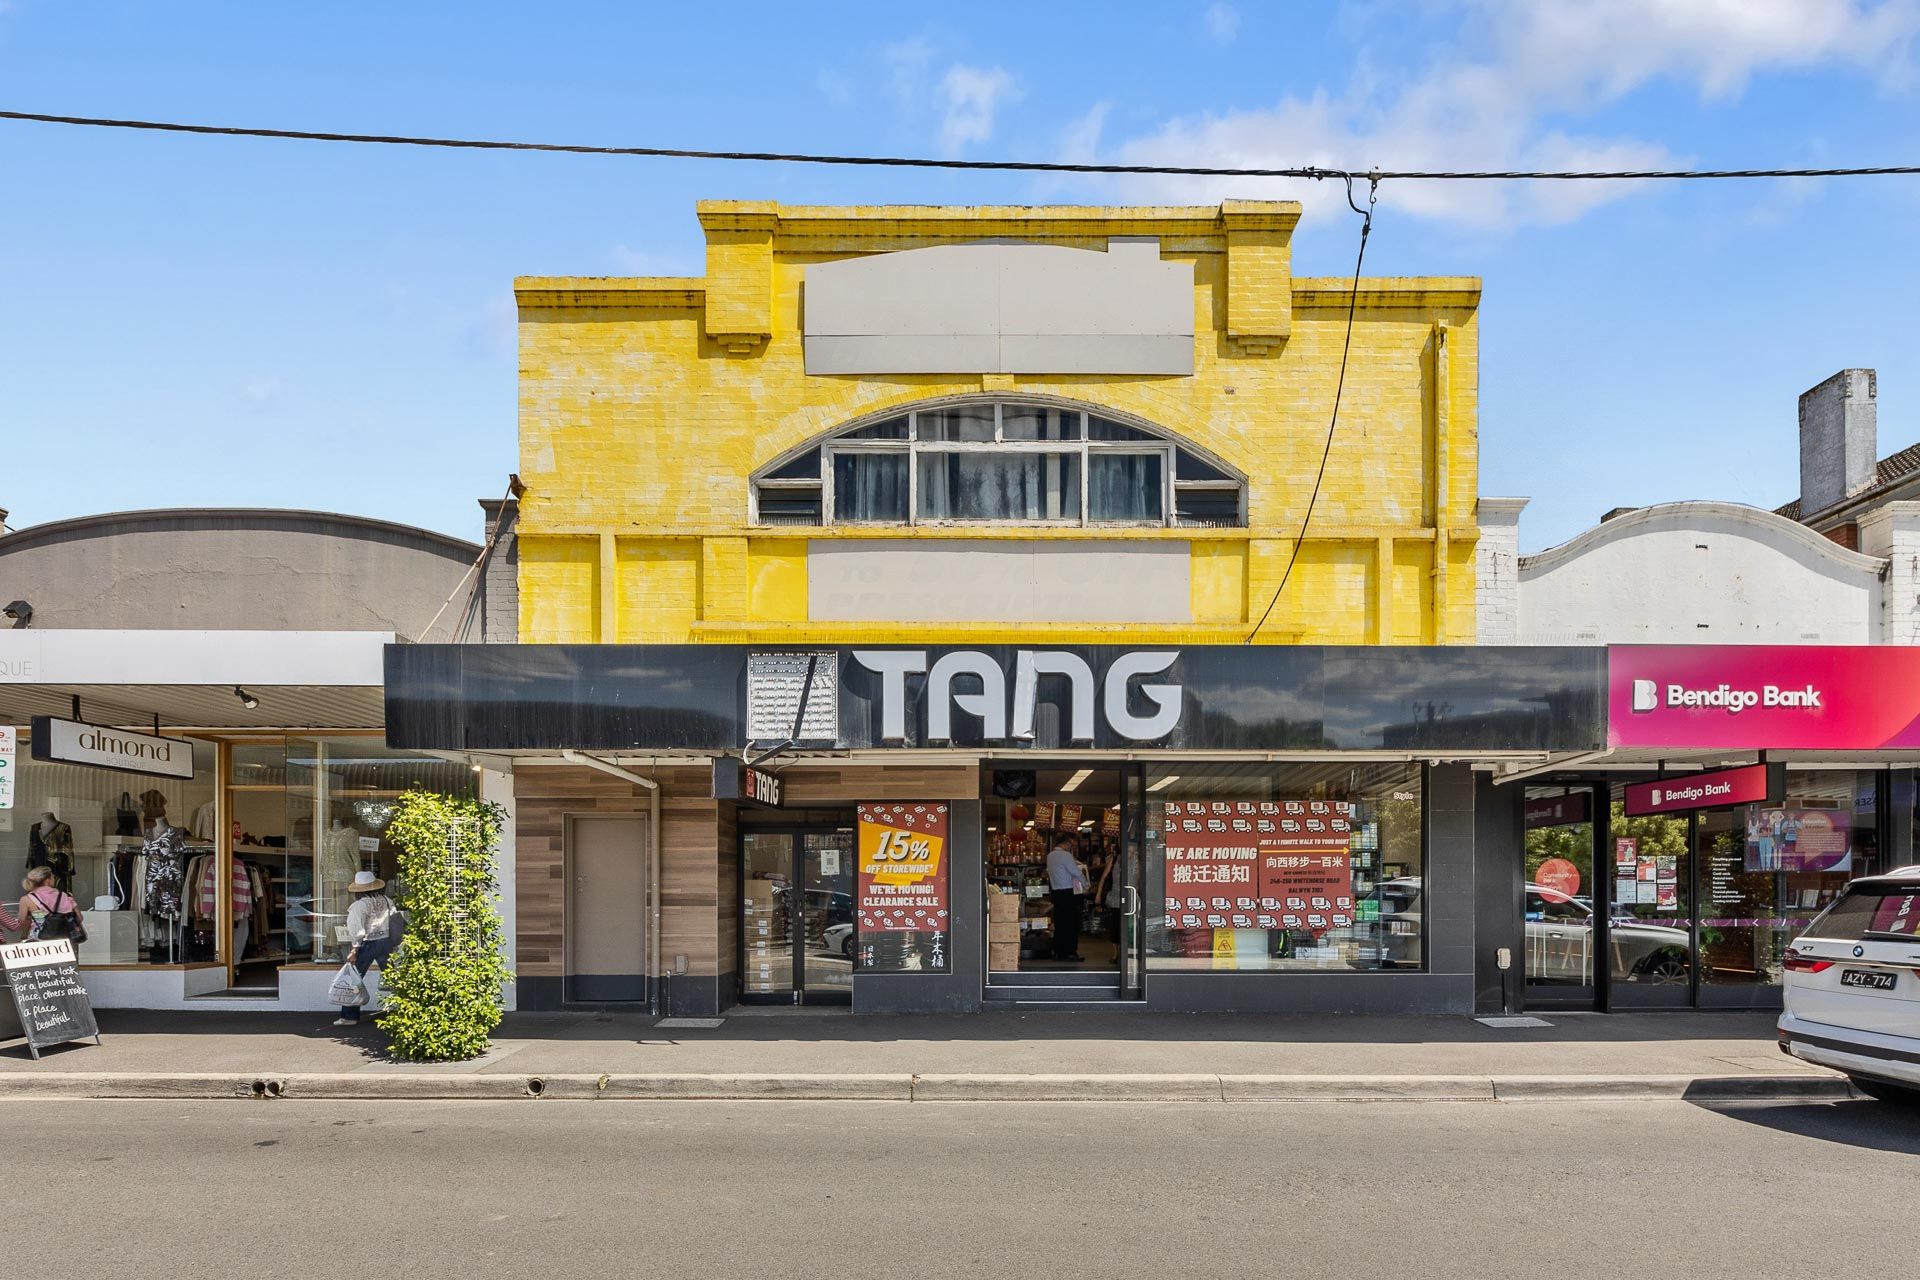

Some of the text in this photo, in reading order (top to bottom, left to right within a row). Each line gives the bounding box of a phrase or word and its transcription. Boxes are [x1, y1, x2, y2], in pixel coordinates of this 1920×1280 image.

[852, 650, 1182, 740] TANG
[1667, 684, 1758, 712] Bendigo
[1764, 685, 1820, 706] Bank
[79, 730, 171, 762] almond
[106, 757, 146, 770] BOUTIQUE
[756, 771, 778, 805] TANG
[1666, 788, 1703, 800] Bendigo
[1706, 782, 1730, 796] Bank
[872, 830, 930, 860] 15%
[1166, 848, 1258, 859] WE ARE MOVING
[866, 864, 880, 874] OFF
[1266, 857, 1343, 868] 向西移步一百米
[1173, 864, 1250, 882] 搬迁通知
[869, 884, 934, 894] WE'RE MOVING!
[864, 897, 938, 906] CLEARANCE SALE
[4, 940, 70, 960] almond
[10, 966, 79, 981] Some people look
[14, 983, 26, 993] for
[37, 977, 75, 988] beautiful
[67, 985, 88, 996] make
[24, 1005, 57, 1017] a place
